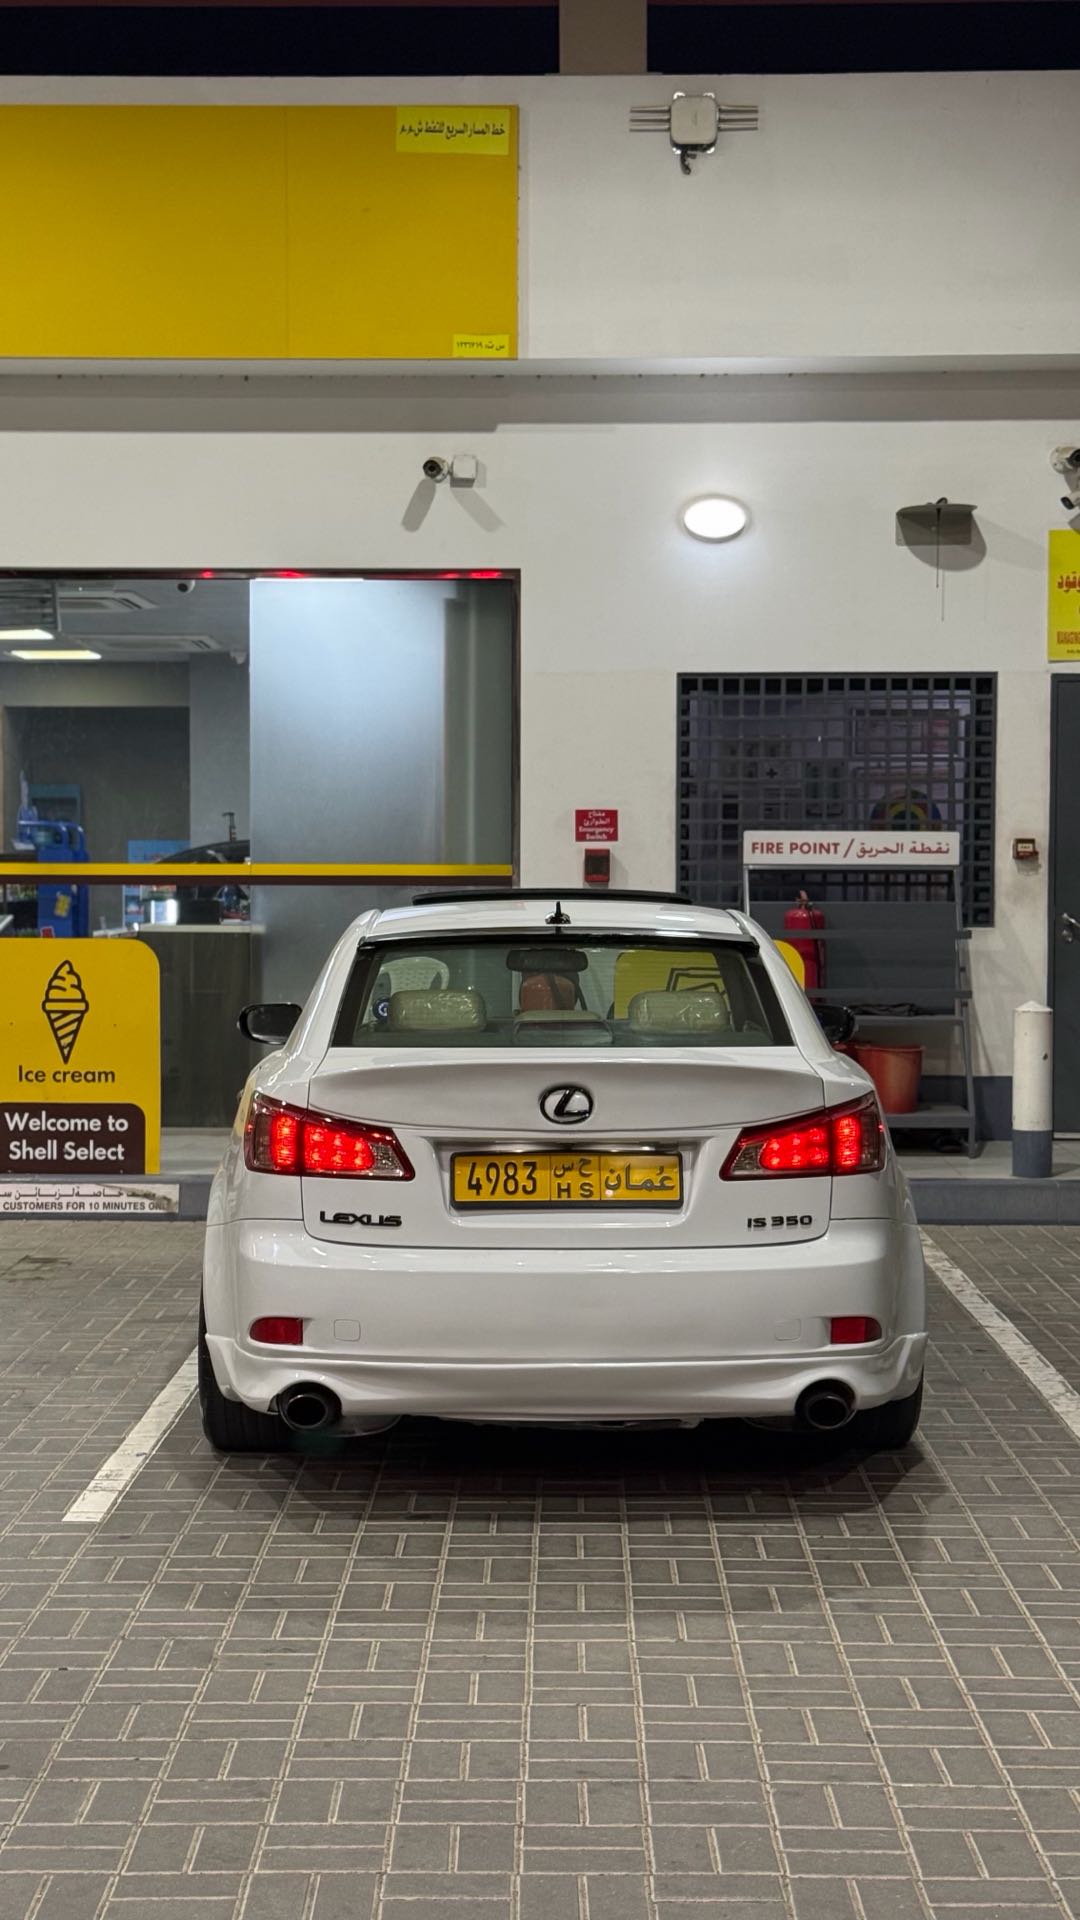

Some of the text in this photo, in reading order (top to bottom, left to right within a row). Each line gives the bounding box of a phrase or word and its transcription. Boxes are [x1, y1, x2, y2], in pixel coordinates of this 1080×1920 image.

[446, 122, 467, 140] السريع
[579, 826, 614, 834] Emergency
[751, 842, 784, 854] FIRE
[789, 842, 840, 854] POINT
[856, 840, 950, 858] نقطة الحريق
[18, 1065, 116, 1083] Ice cream
[4, 1110, 129, 1132] Welcome to
[9, 1139, 125, 1160] Shell Select
[467, 1161, 537, 1196] 4983
[3, 1202, 173, 1211] CUSTOMERS FOR 10 MINUTES ONL
[320, 1211, 402, 1227] LEXUS
[747, 1215, 812, 1228] IS 350
